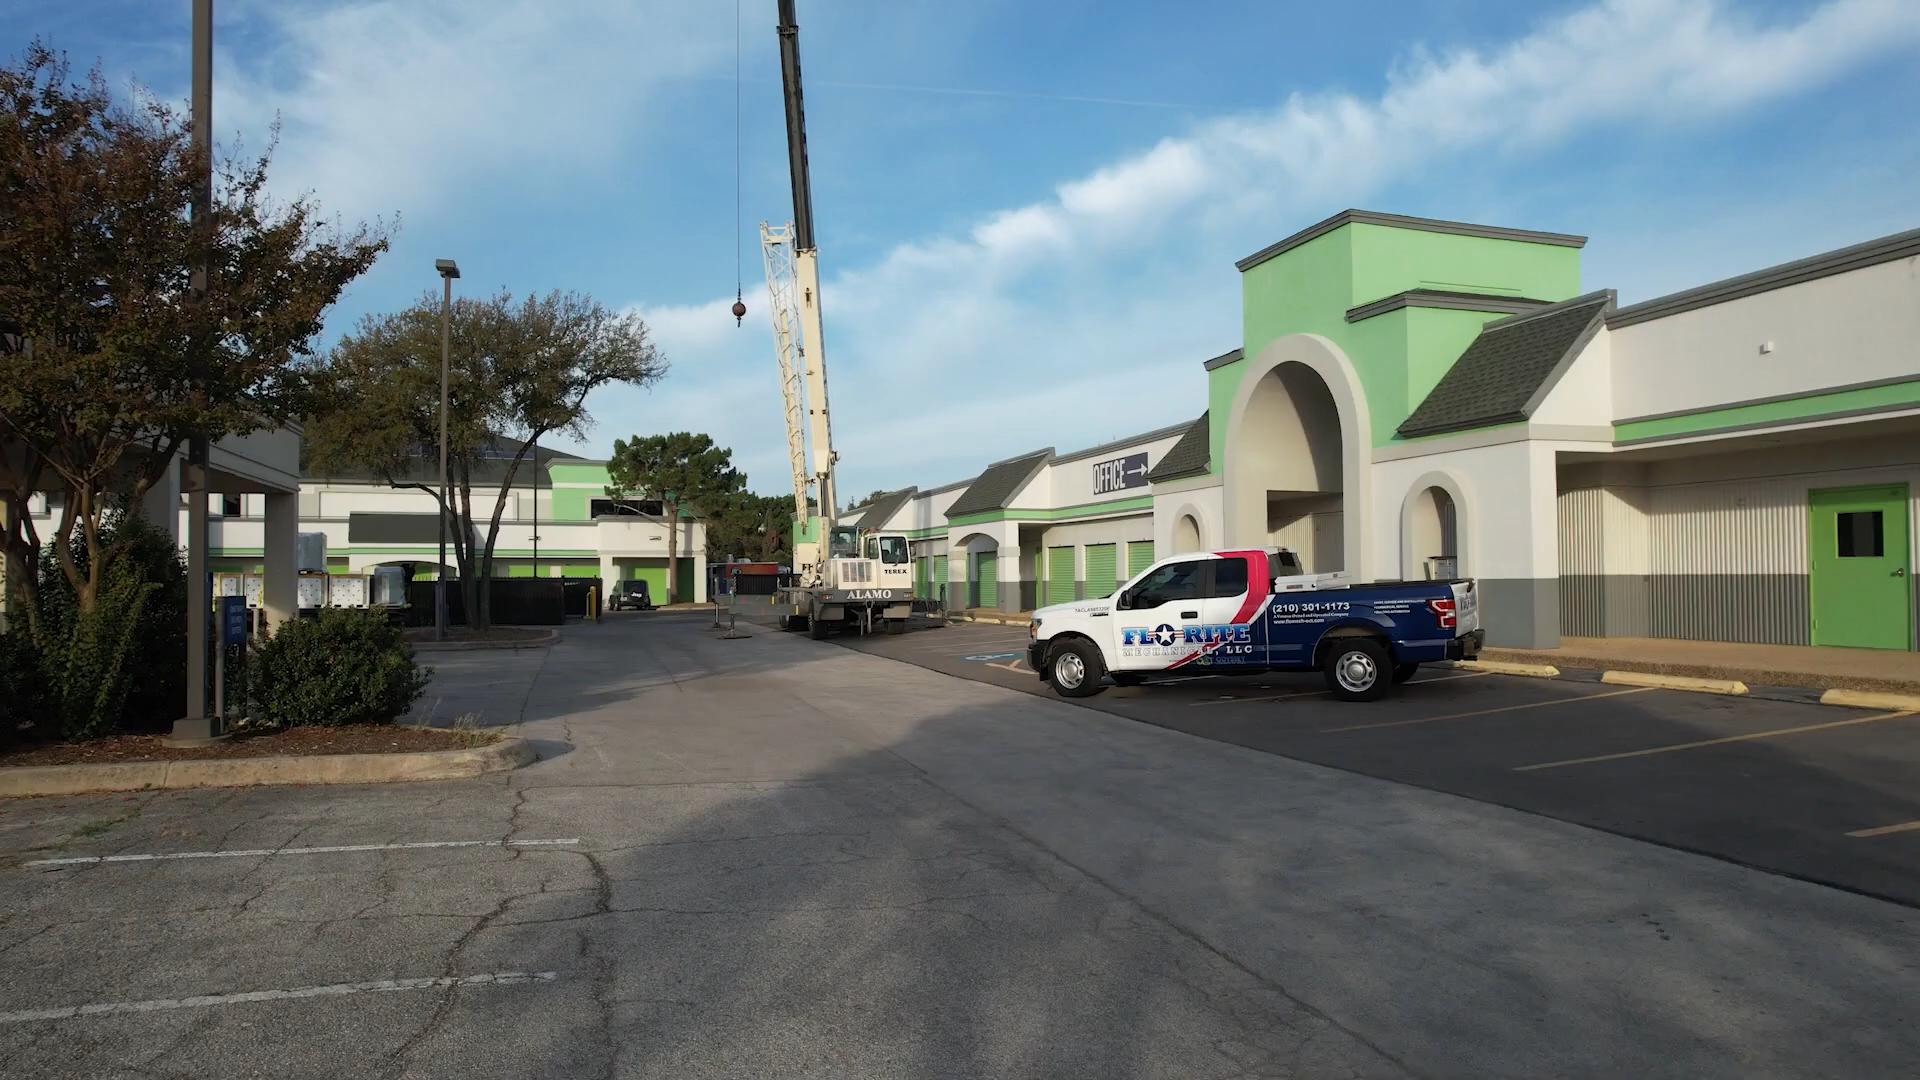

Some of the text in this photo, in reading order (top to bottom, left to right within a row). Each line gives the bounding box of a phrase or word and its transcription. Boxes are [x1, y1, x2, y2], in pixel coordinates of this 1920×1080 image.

[1093, 459, 1126, 494] OFFICE
[847, 589, 892, 600] ALAMO
[1272, 602, 1350, 614] (210) 301-1173
[1226, 645, 1253, 654] LLC
